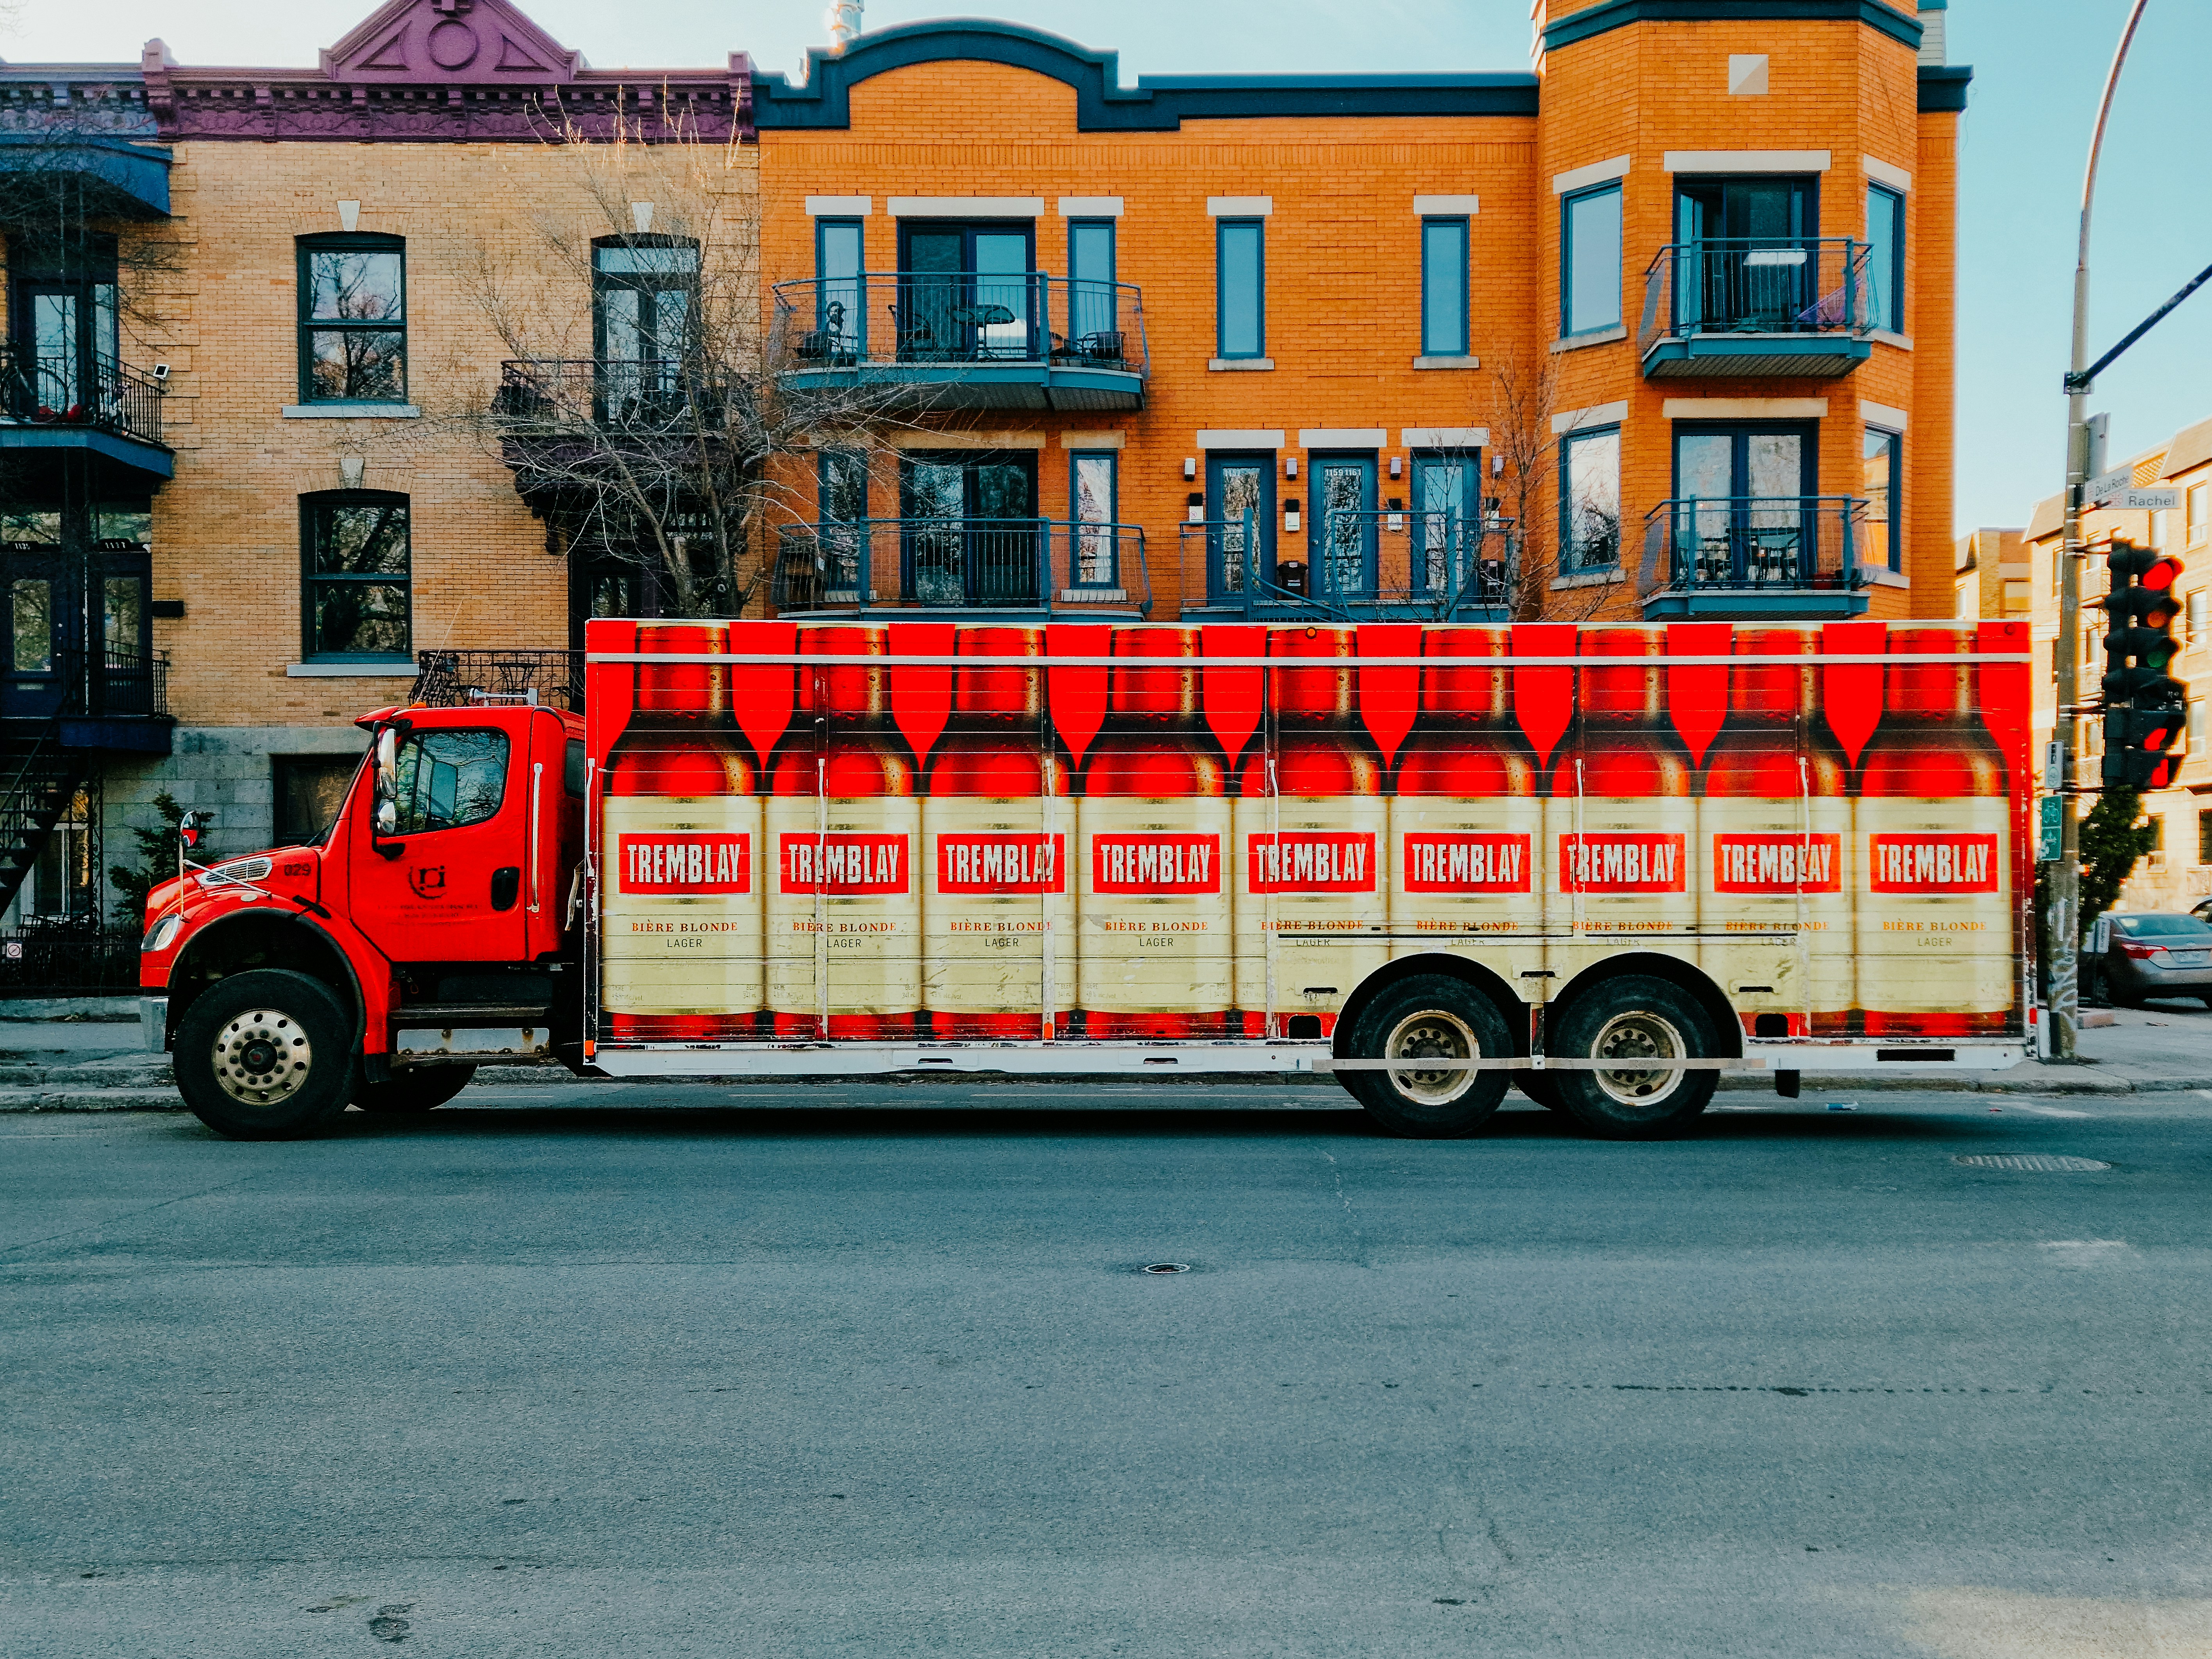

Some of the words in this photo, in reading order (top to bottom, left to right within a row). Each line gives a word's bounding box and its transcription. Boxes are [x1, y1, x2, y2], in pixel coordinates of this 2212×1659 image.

[2112, 474, 2130, 489] Roche
[2129, 495, 2175, 506] Rachel
[627, 844, 740, 883] TREMBLAY
[788, 844, 899, 883] TREMBLAY
[946, 844, 1055, 882] TREMBLAY
[1101, 844, 1211, 883] TREMBLAY
[1256, 843, 1366, 882] TREMBLAY
[1412, 844, 1522, 883] TREMBLAY
[1567, 844, 1676, 882] TREMBLAY
[1721, 844, 1832, 883] TREMBLAY
[1878, 844, 1988, 883] TREMBLAY
[632, 919, 674, 932] BIÈRE
[680, 922, 738, 932] BLONDE
[793, 918, 833, 932] BIÈRE
[840, 922, 896, 932] BLONDE
[951, 918, 992, 931] BIÈRE
[997, 921, 1053, 931] BLONDE
[1105, 918, 1146, 931] BIÈRE
[1152, 921, 1208, 931] BLONDE
[1261, 918, 1301, 930] BIÈRE
[1309, 920, 1363, 930] BLONDE
[1417, 917, 1456, 930] BIÈRE
[1572, 918, 1612, 931] BIÈRE
[1618, 921, 1673, 930] BLONDE
[1883, 918, 1924, 931] BIÈRE
[1930, 921, 1987, 931] BLONDE
[667, 938, 703, 948] LAGER
[827, 938, 861, 948] LAGER
[985, 938, 1019, 947] LAGER
[1140, 938, 1174, 947] LAGER
[1296, 939, 1330, 947] LAGER
[1918, 937, 1952, 946] LAGER
